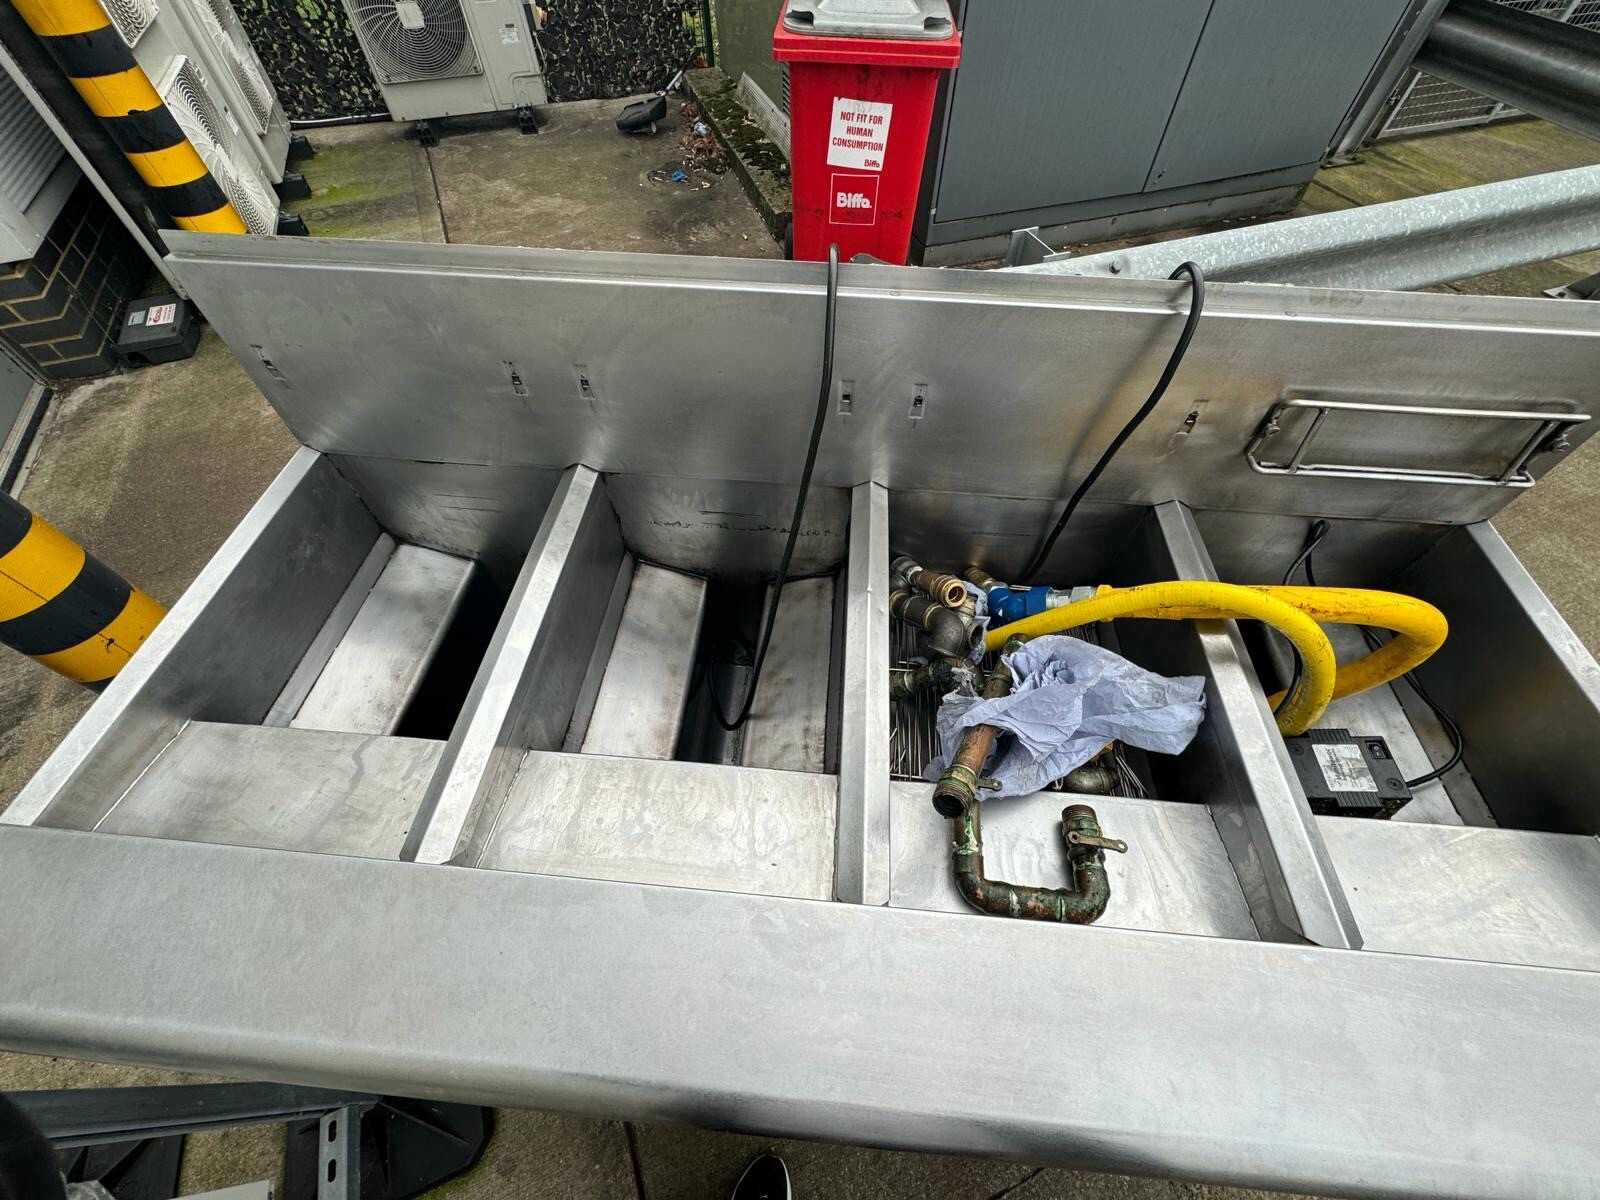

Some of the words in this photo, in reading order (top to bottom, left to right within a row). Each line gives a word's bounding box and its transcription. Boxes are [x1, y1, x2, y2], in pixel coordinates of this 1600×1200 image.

[840, 111, 855, 121] NOT
[856, 113, 867, 123] FIT
[869, 115, 883, 125] FOR
[846, 126, 874, 137] HUMAN
[832, 137, 884, 151] CONSUMPTION
[864, 159, 880, 168] Biffa
